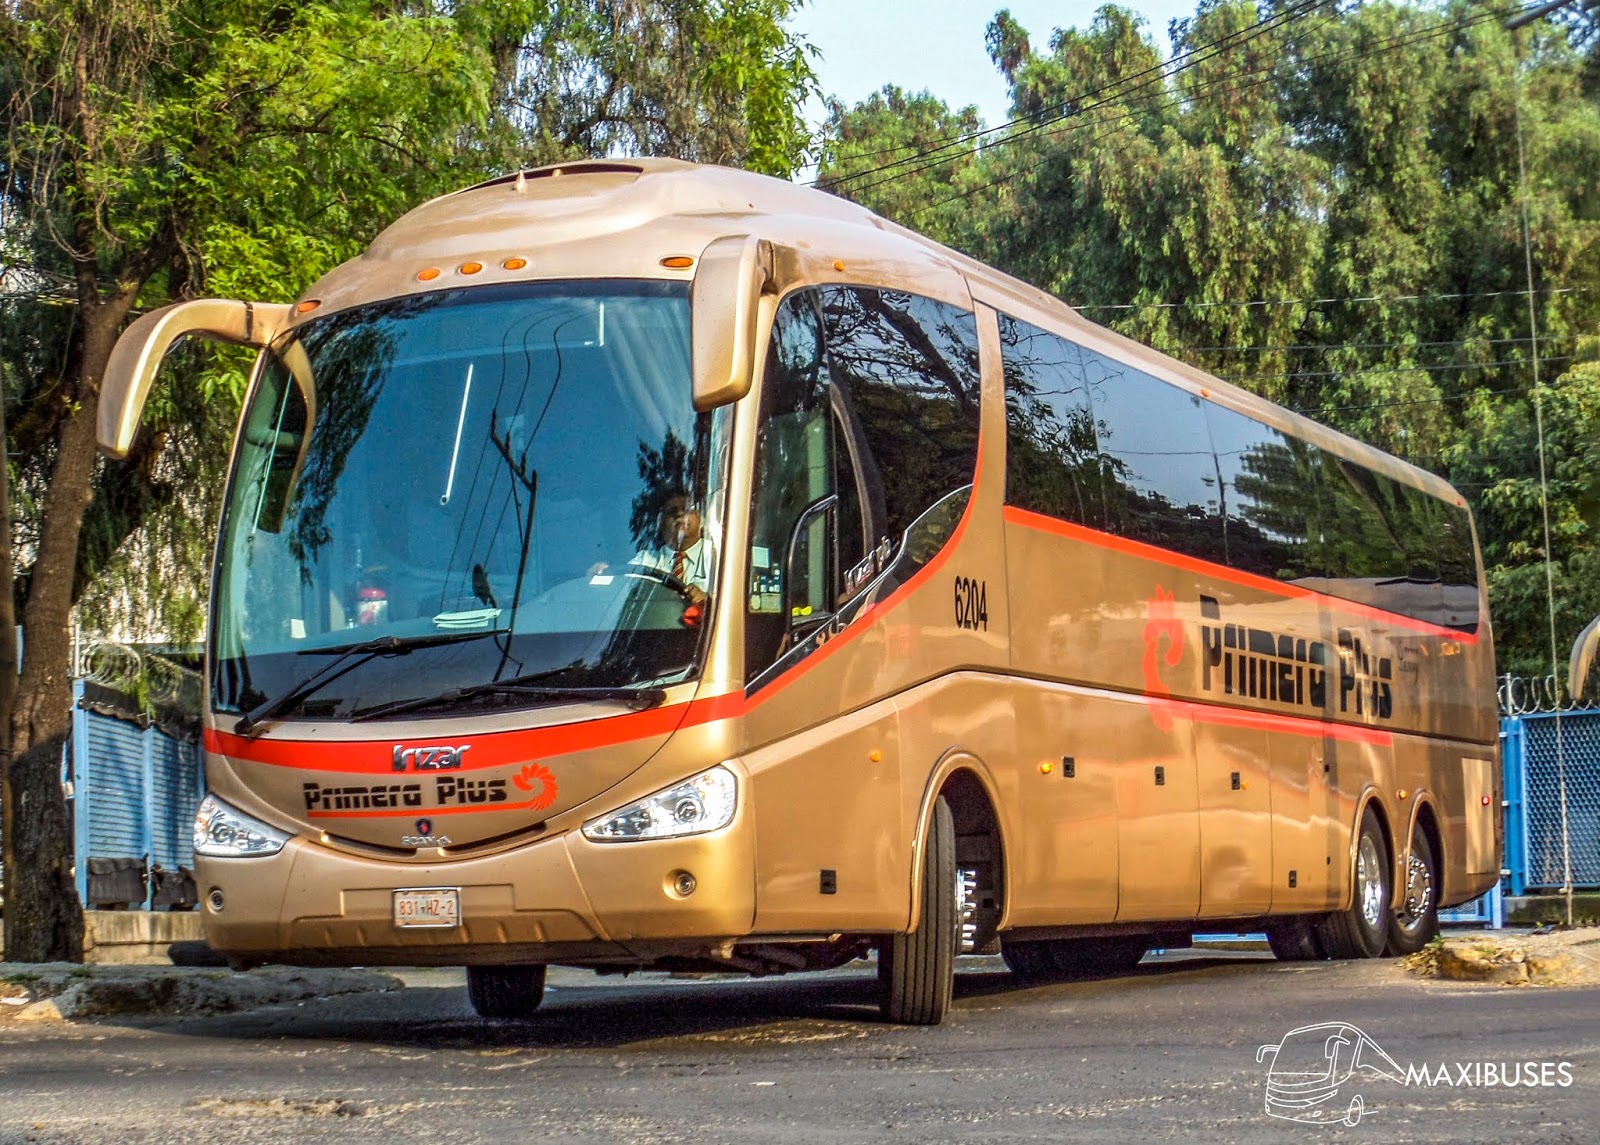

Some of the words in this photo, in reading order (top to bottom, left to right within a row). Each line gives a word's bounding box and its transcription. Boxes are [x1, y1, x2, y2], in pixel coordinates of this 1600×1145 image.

[954, 575, 988, 632] 6204
[1199, 594, 1327, 708] Primera
[1337, 626, 1393, 719] Plus
[393, 745, 471, 771] Irizar
[303, 782, 422, 810] Primera
[436, 776, 507, 805] Plus
[402, 835, 452, 845] SCANA
